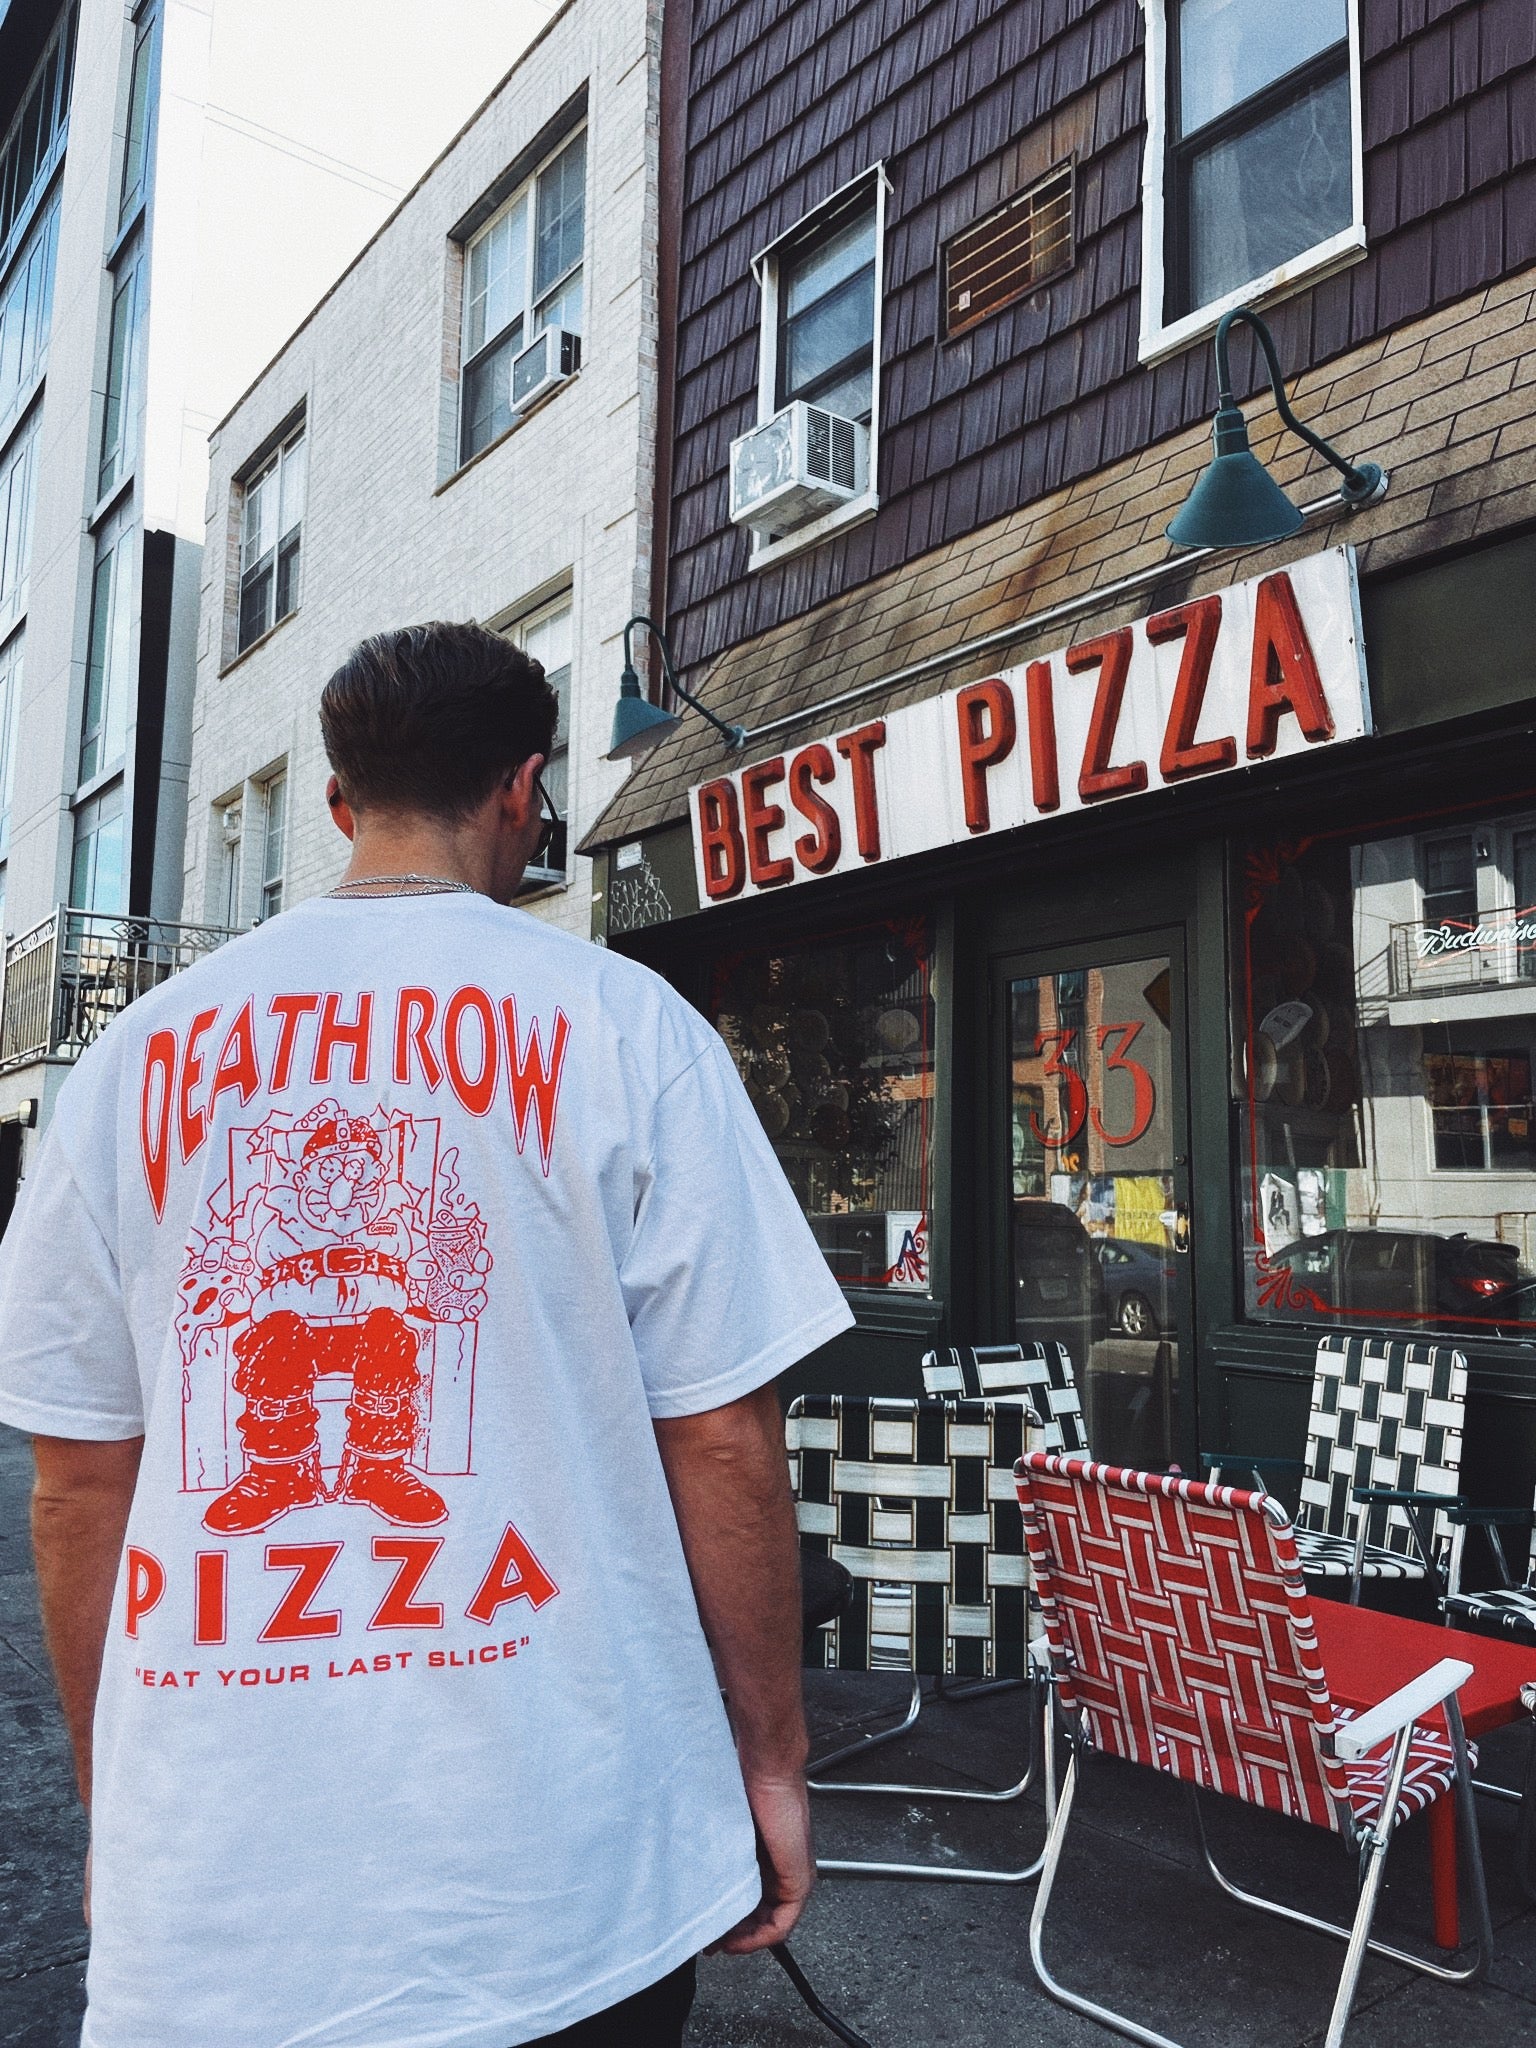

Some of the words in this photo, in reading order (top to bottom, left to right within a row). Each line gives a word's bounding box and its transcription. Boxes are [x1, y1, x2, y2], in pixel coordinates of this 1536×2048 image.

[697, 721, 886, 902] BEST
[956, 570, 1337, 835] PIZZA
[139, 990, 375, 1224] DEATH
[393, 983, 573, 1178] ROW
[1029, 1020, 1157, 1148] 33
[897, 1230, 922, 1269] A
[125, 1520, 561, 1646] PIZZA
[217, 1664, 311, 1687] YOUR
[328, 1651, 413, 1678] LAST
